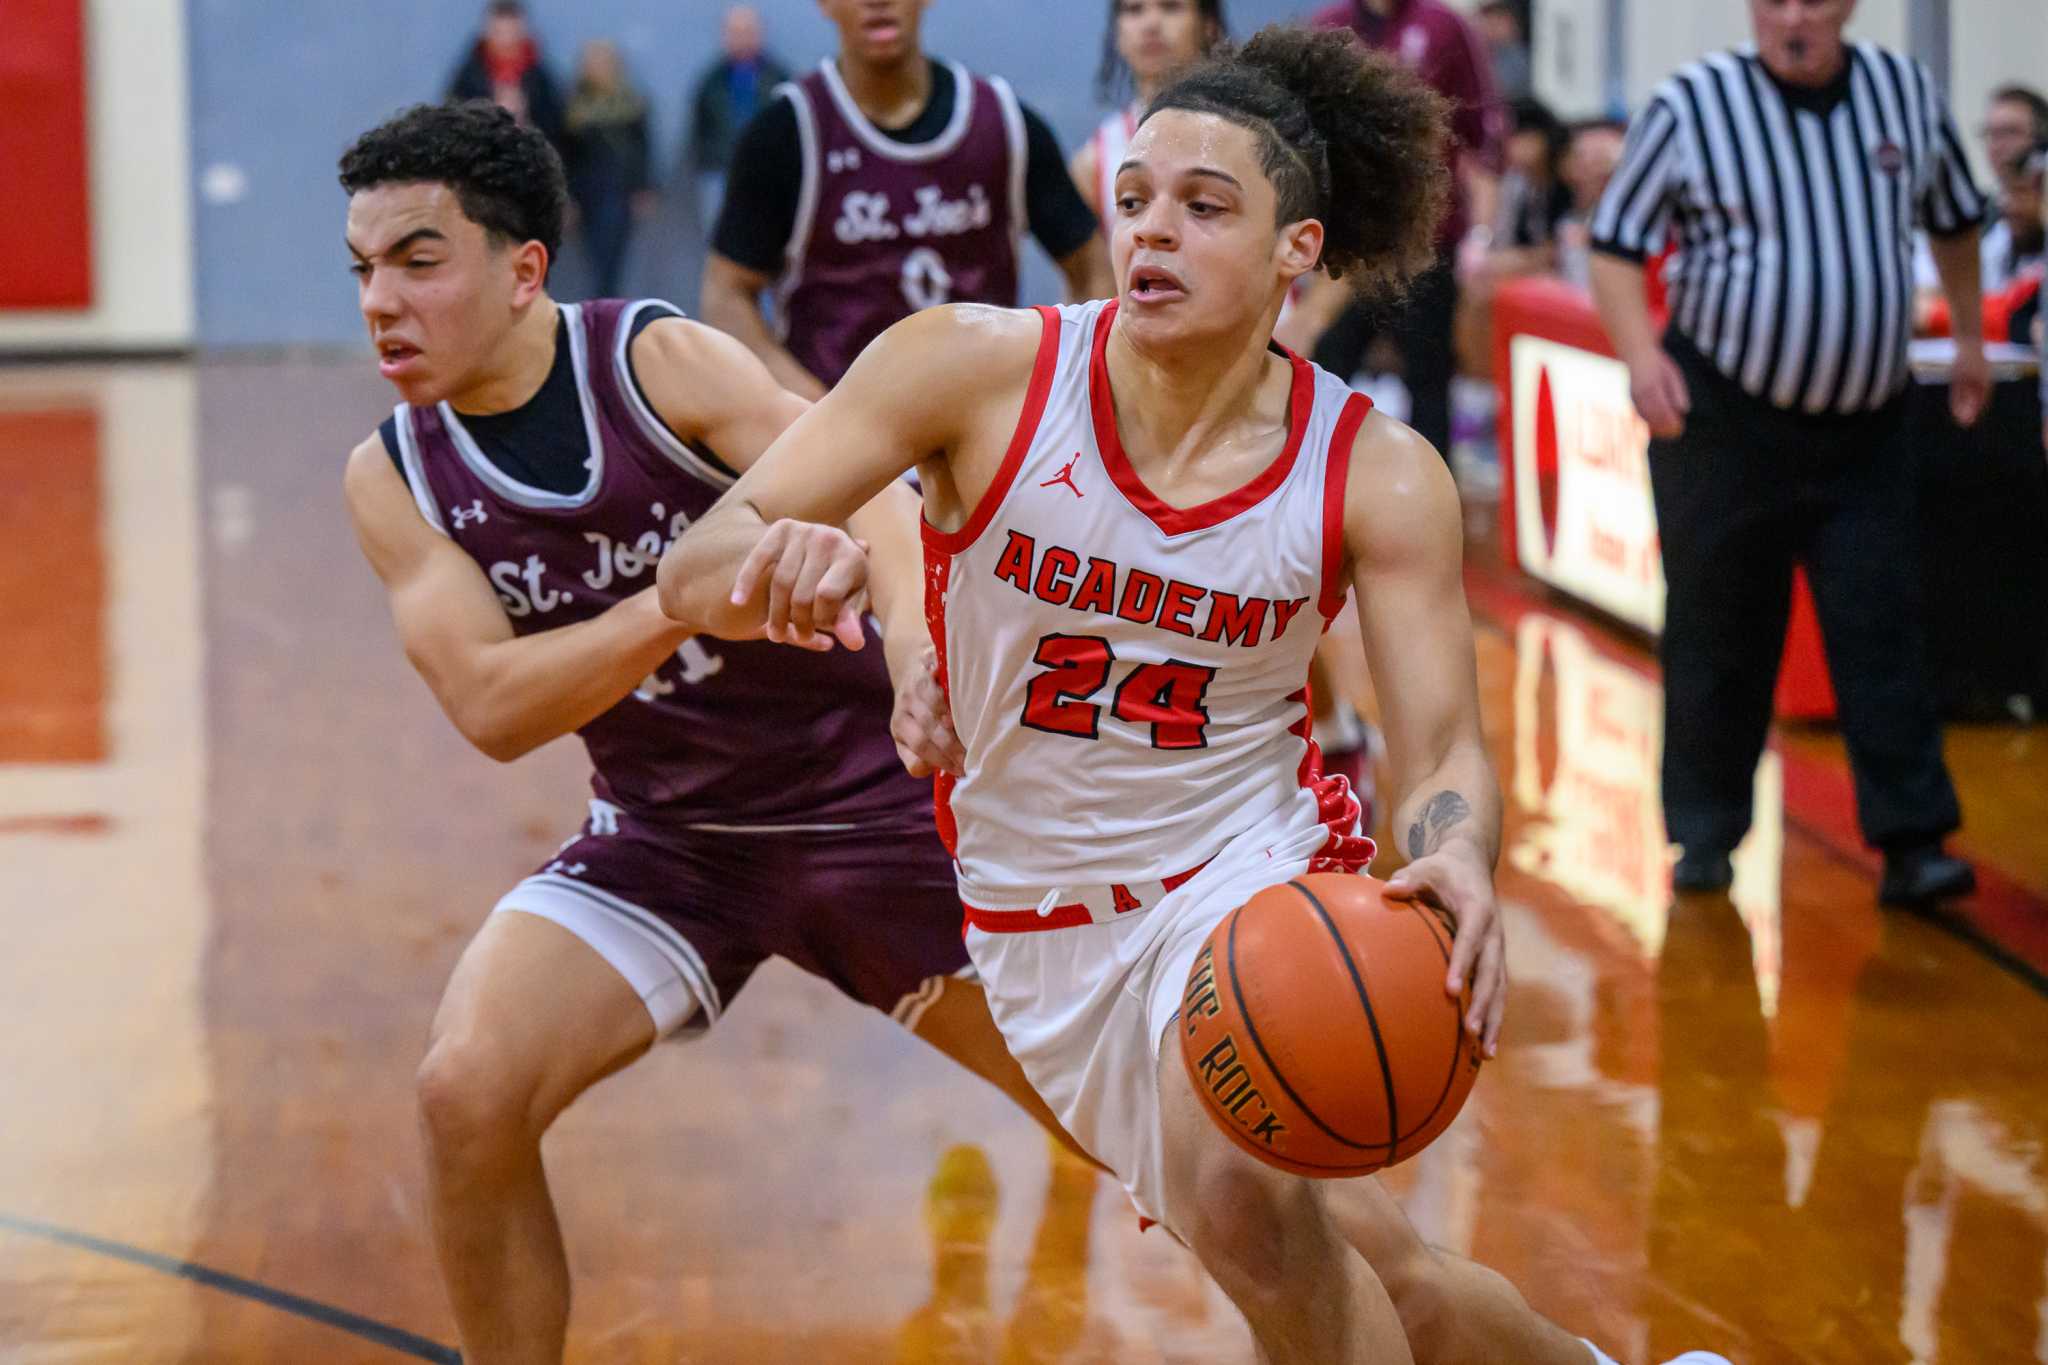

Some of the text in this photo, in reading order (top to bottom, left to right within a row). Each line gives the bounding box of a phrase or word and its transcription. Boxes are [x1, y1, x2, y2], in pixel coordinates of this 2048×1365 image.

[834, 190, 900, 244] St.
[900, 246, 953, 311] 0
[489, 554, 574, 617] St.
[994, 529, 1310, 648] ACADEMY
[1020, 632, 1221, 750] 24
[1110, 883, 1142, 914] A
[1198, 1033, 1287, 1146] ROCK
